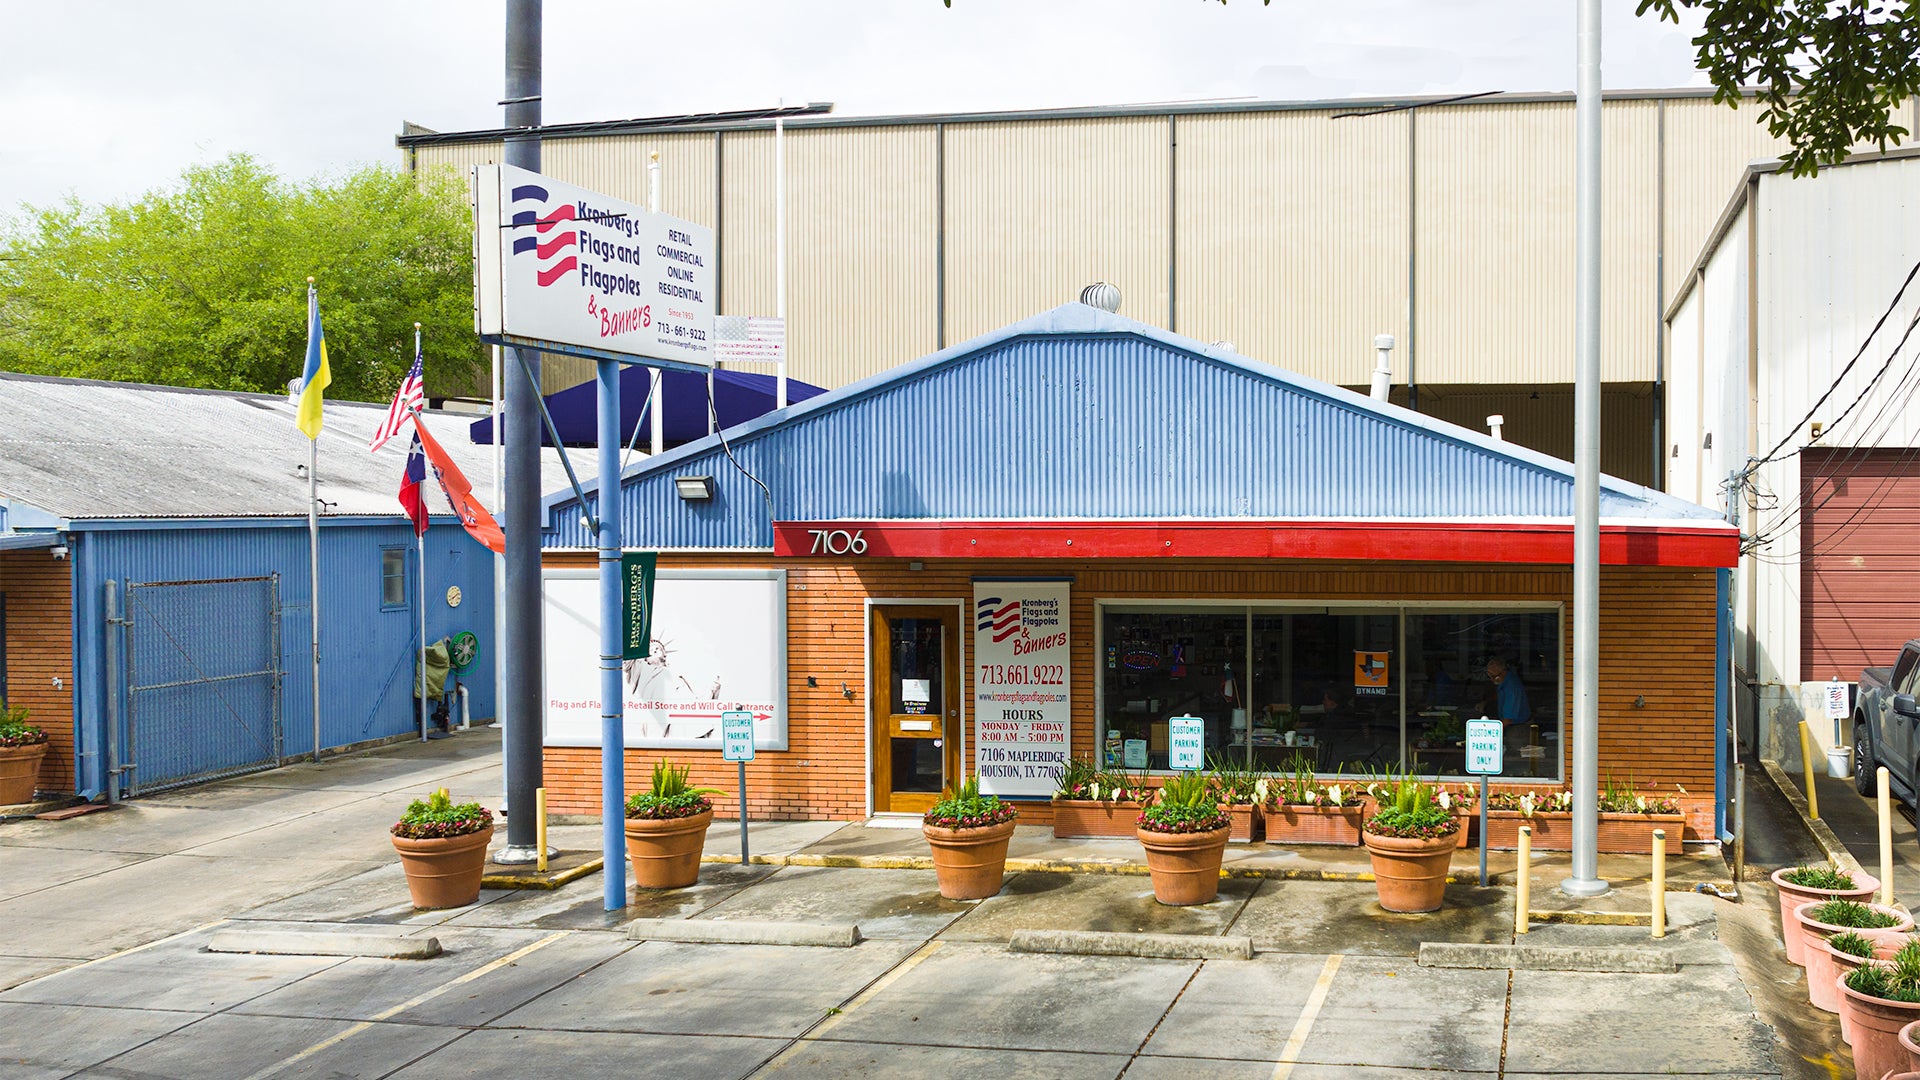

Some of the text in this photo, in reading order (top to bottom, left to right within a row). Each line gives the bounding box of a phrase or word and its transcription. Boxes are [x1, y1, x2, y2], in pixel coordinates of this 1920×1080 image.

[668, 229, 692, 246] RETAIL
[580, 230, 640, 266] Flags and
[657, 245, 704, 267] COMMERCIAL
[581, 262, 640, 296] Flagpoles
[667, 266, 694, 283] ONLINE
[658, 282, 703, 303] RESIDENTIAL
[588, 294, 598, 319] &
[668, 308, 694, 320] Since 1953
[600, 305, 651, 338] Banners
[807, 529, 868, 554] 7106
[630, 564, 638, 648] KRONBERG'S
[1021, 598, 1058, 608] Kronberg's
[1022, 608, 1058, 617] Flags and
[1022, 617, 1058, 627] Flagpoles
[1021, 627, 1030, 639] &
[1012, 632, 1067, 656] Banners
[1123, 654, 1161, 667] OPEN
[981, 665, 1063, 685] 713.661.9222
[1356, 687, 1386, 695] DYNAMO
[550, 700, 568, 710] Flag
[571, 701, 587, 709] and
[628, 701, 653, 709] Retail
[654, 701, 678, 710] Store
[680, 702, 696, 710] and
[698, 702, 715, 710] Will
[717, 702, 733, 711] Call
[1002, 709, 1044, 720] HOURS
[724, 719, 751, 727] CUSTOMER
[981, 722, 1020, 731] MONDAY
[1031, 723, 1064, 731] FRIDAY
[1173, 725, 1200, 735] CUSTOMER
[1470, 728, 1499, 737] CUSTOMER
[727, 732, 749, 740] PARKING
[981, 732, 1001, 741] 8:00
[1004, 733, 1018, 741] AM
[1028, 733, 1047, 742] 5:00
[1050, 733, 1064, 742] PM
[732, 744, 746, 753] ONLY
[1175, 739, 1198, 748] PARKING
[1472, 742, 1497, 751] PARKING
[981, 748, 1065, 762] 7106 MAPLERIDGE
[1179, 753, 1194, 761] ONLY
[1476, 756, 1492, 765] ONLY
[981, 765, 1022, 779] HOUSTON,
[1024, 765, 1036, 778] TX
